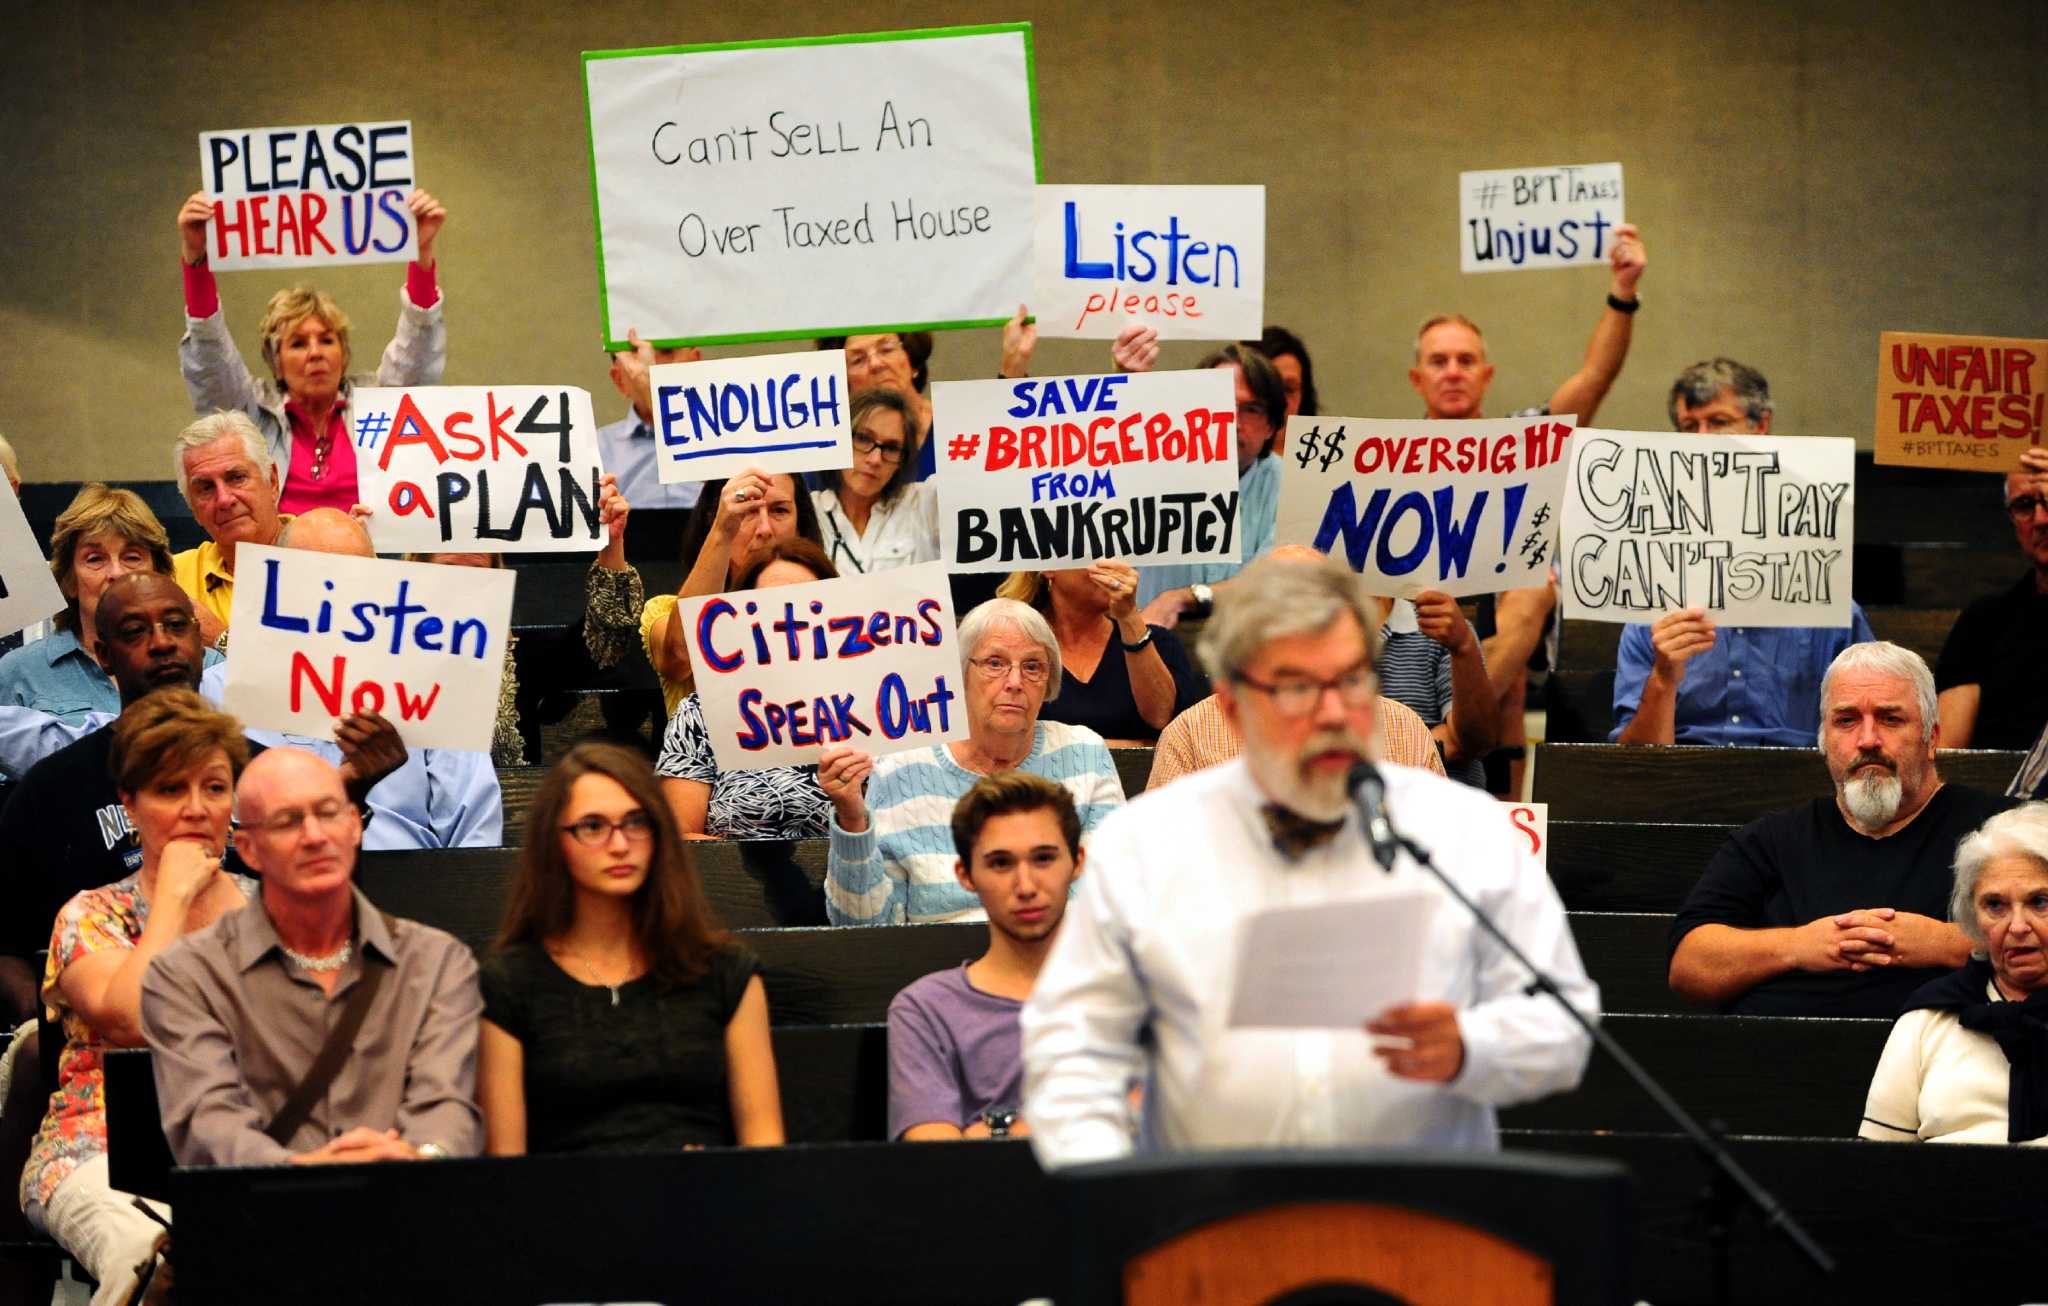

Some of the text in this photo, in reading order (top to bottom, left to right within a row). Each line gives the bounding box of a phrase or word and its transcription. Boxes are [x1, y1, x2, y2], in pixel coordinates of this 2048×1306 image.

[876, 100, 932, 151] An
[210, 126, 412, 192] PLEASE
[214, 190, 410, 258] HEAR US
[679, 198, 992, 257] Over Taxed House
[1064, 201, 1240, 288] Listen
[1077, 287, 1204, 329] please
[1007, 376, 1128, 418] SAVE
[1892, 343, 2036, 395] UNFAIR
[658, 374, 841, 446] ENOUGH
[1892, 392, 2045, 445] TAXES!
[1354, 422, 1573, 474] OVERSIGHT
[1032, 468, 1116, 502] FROM
[1577, 439, 1850, 540] CAN'T PAY
[957, 491, 1240, 564] BANKRUPTCY
[1571, 534, 1842, 611] CAN'T STAY
[261, 559, 488, 659] Listen
[737, 672, 956, 752] SPEAK Out
